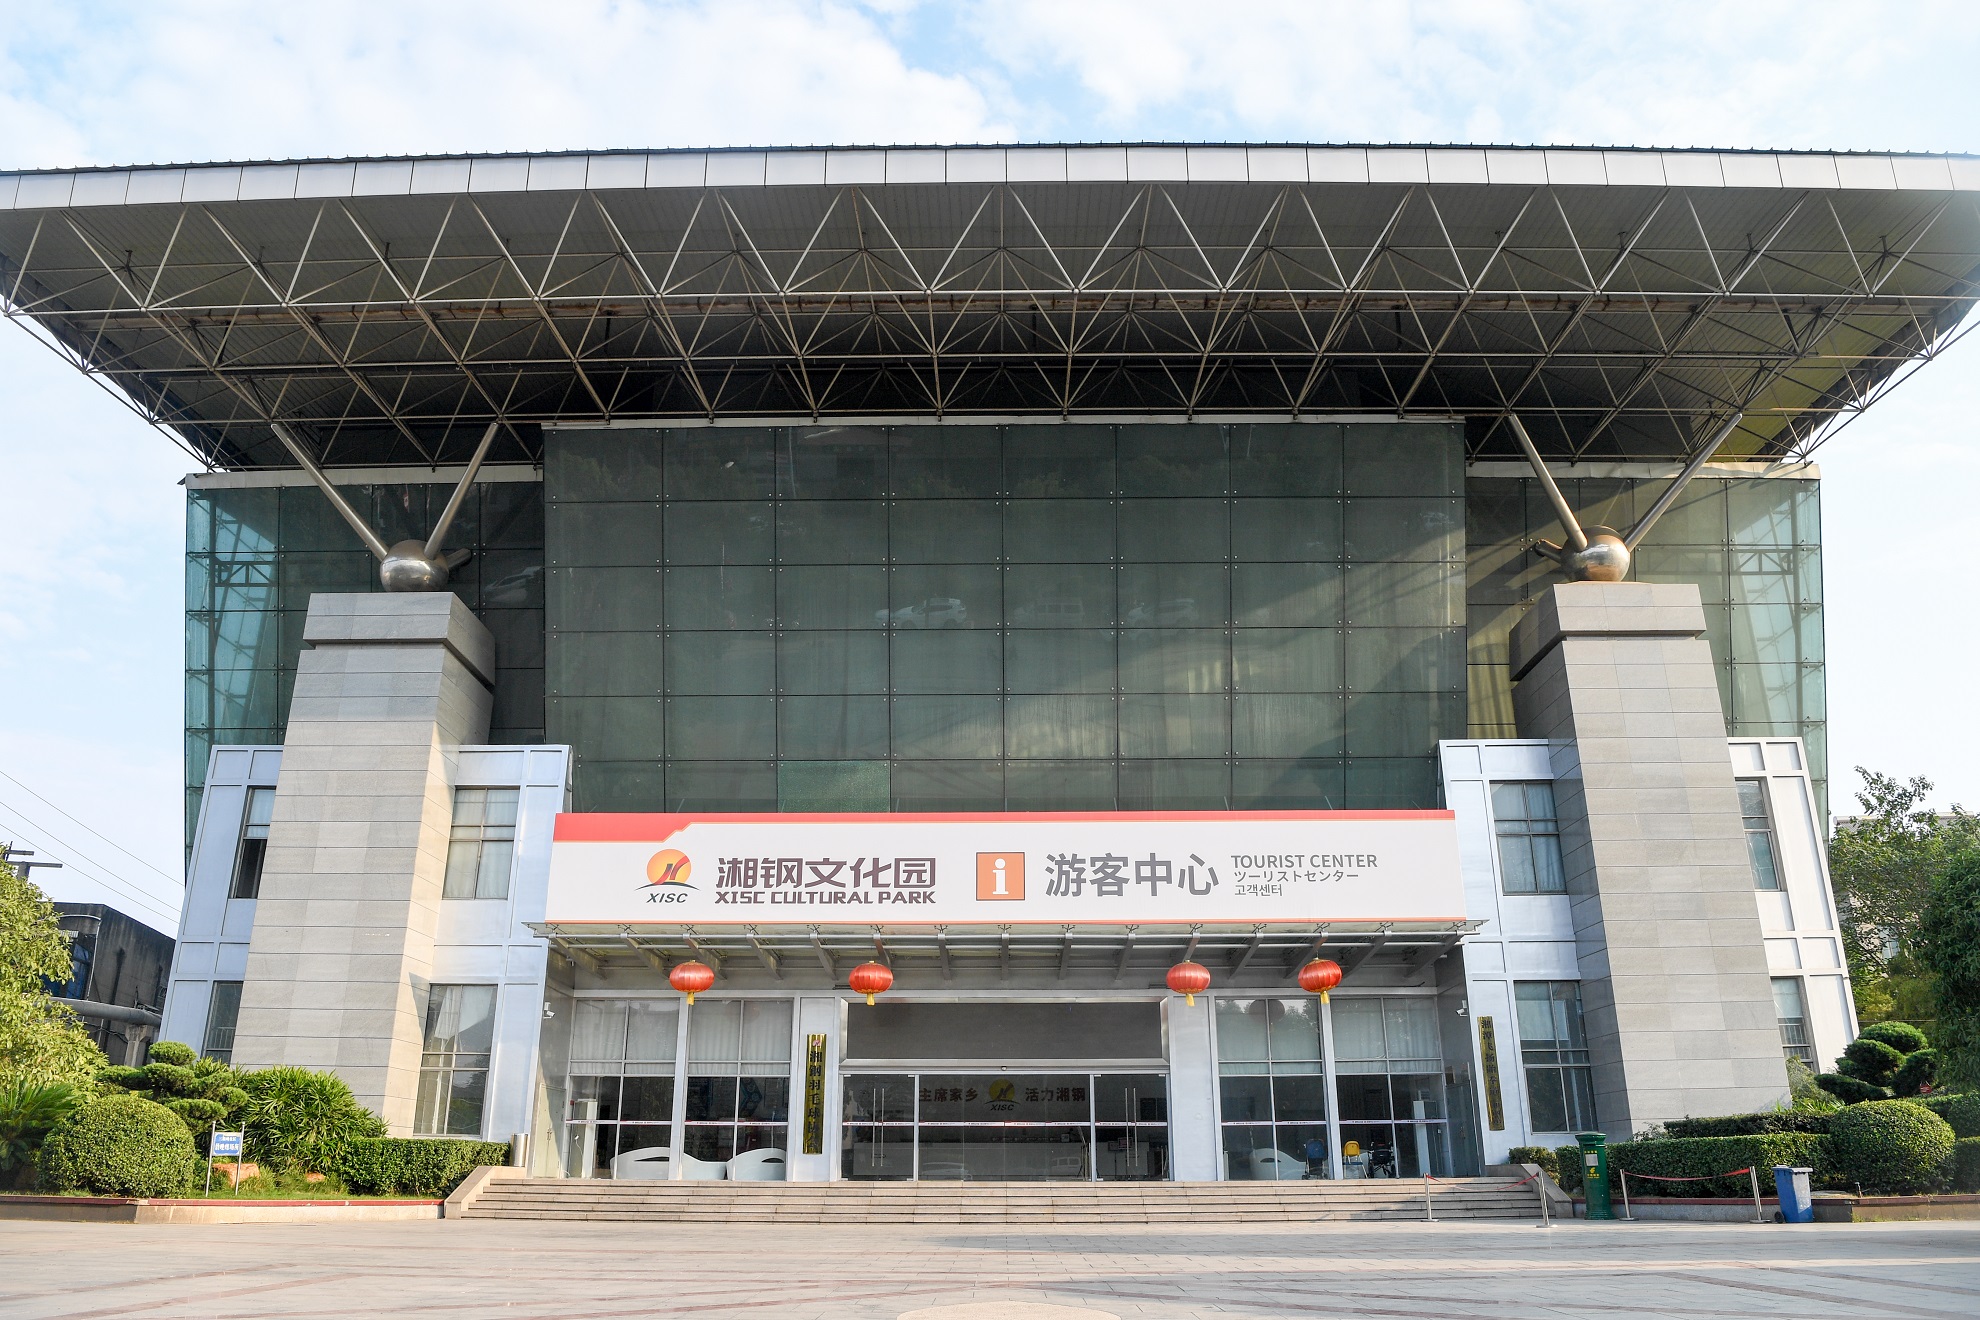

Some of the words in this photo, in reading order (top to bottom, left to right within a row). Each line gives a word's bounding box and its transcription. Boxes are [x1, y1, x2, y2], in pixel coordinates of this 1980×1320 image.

[1231, 854, 1305, 869] TOURIST
[1309, 853, 1379, 868] CENTER
[716, 857, 936, 889] 湘钢文化园
[1045, 852, 1220, 897] 游客中心
[1234, 869, 1359, 883] ツーリストセンター
[715, 891, 766, 904] XISC
[770, 891, 874, 904] CULTURAL
[878, 890, 937, 904] PARK
[1234, 884, 1283, 897] 고객센터
[646, 892, 689, 904] XISC
[919, 1087, 978, 1102] 主席家乡
[1025, 1087, 1086, 1102] 活力湘钢
[990, 1103, 1015, 1111] XISC
